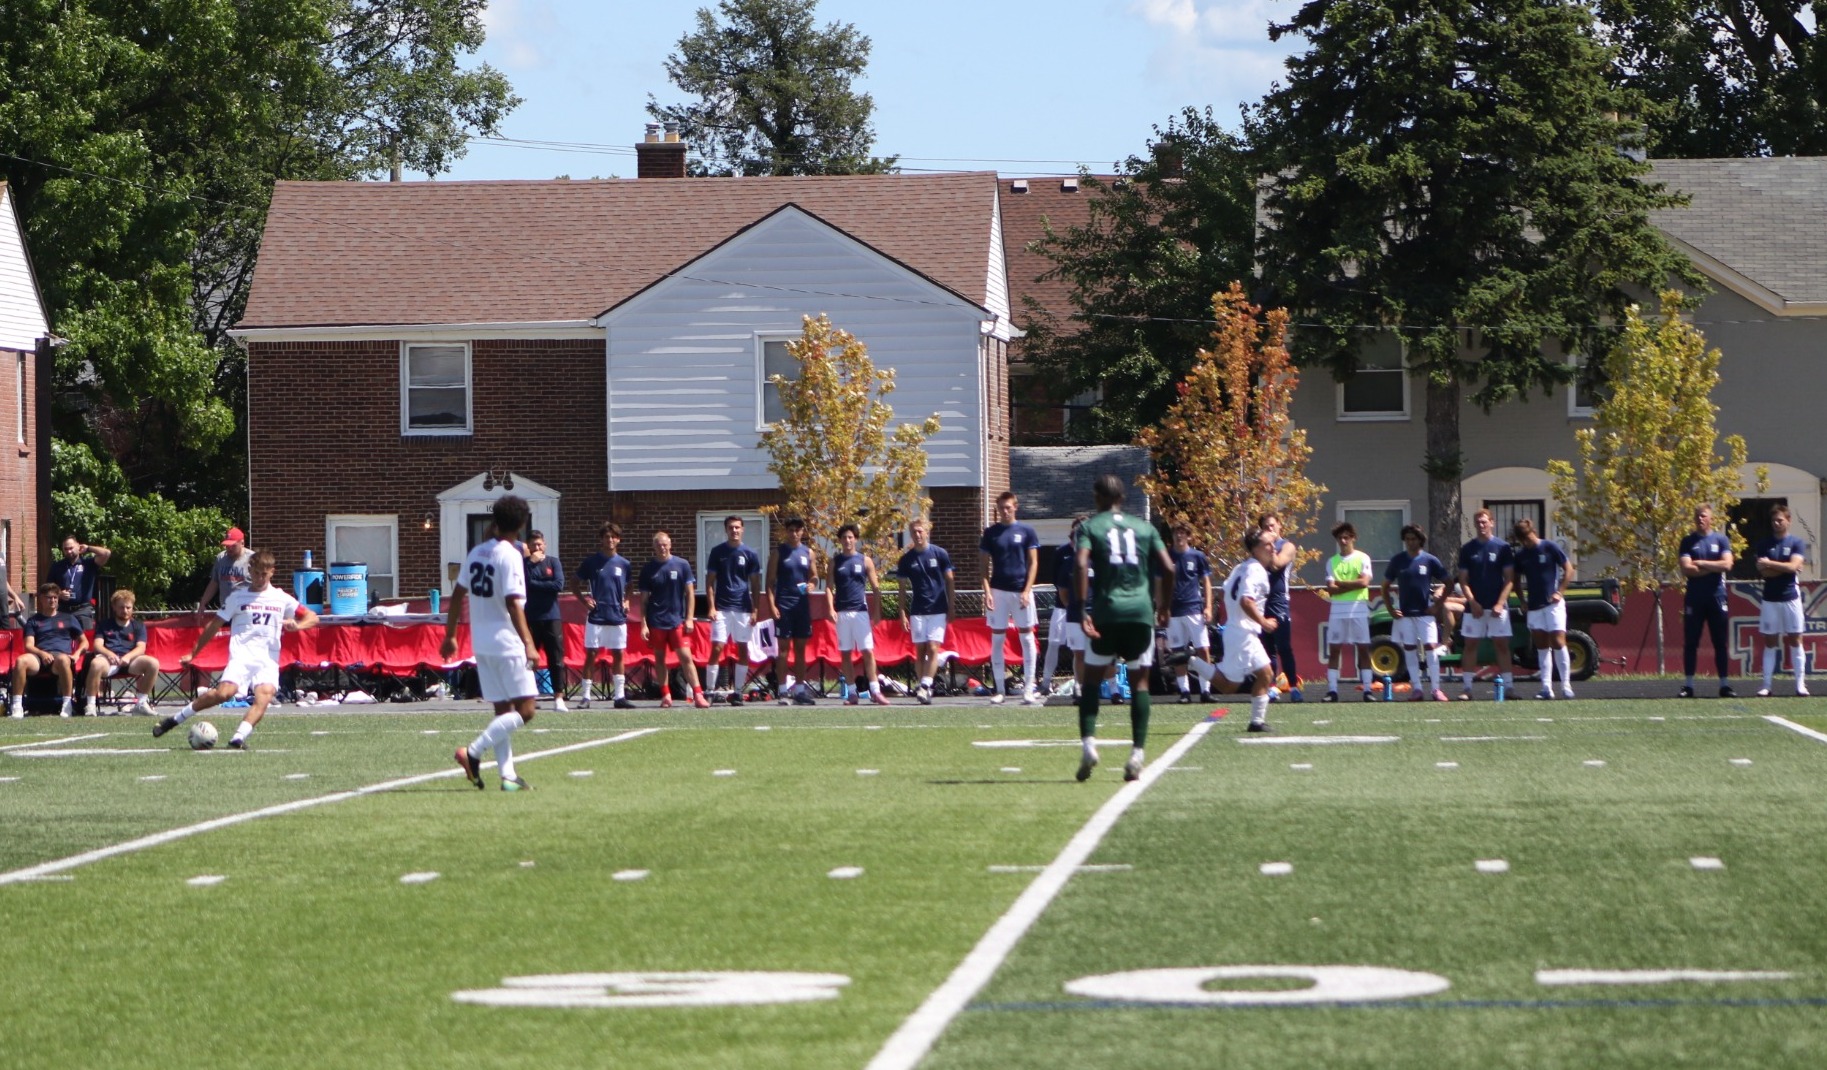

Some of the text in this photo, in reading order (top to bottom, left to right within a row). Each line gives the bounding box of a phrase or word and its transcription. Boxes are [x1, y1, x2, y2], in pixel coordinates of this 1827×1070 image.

[1106, 527, 1139, 565] 11
[469, 561, 496, 598] 26
[252, 612, 272, 626] 27
